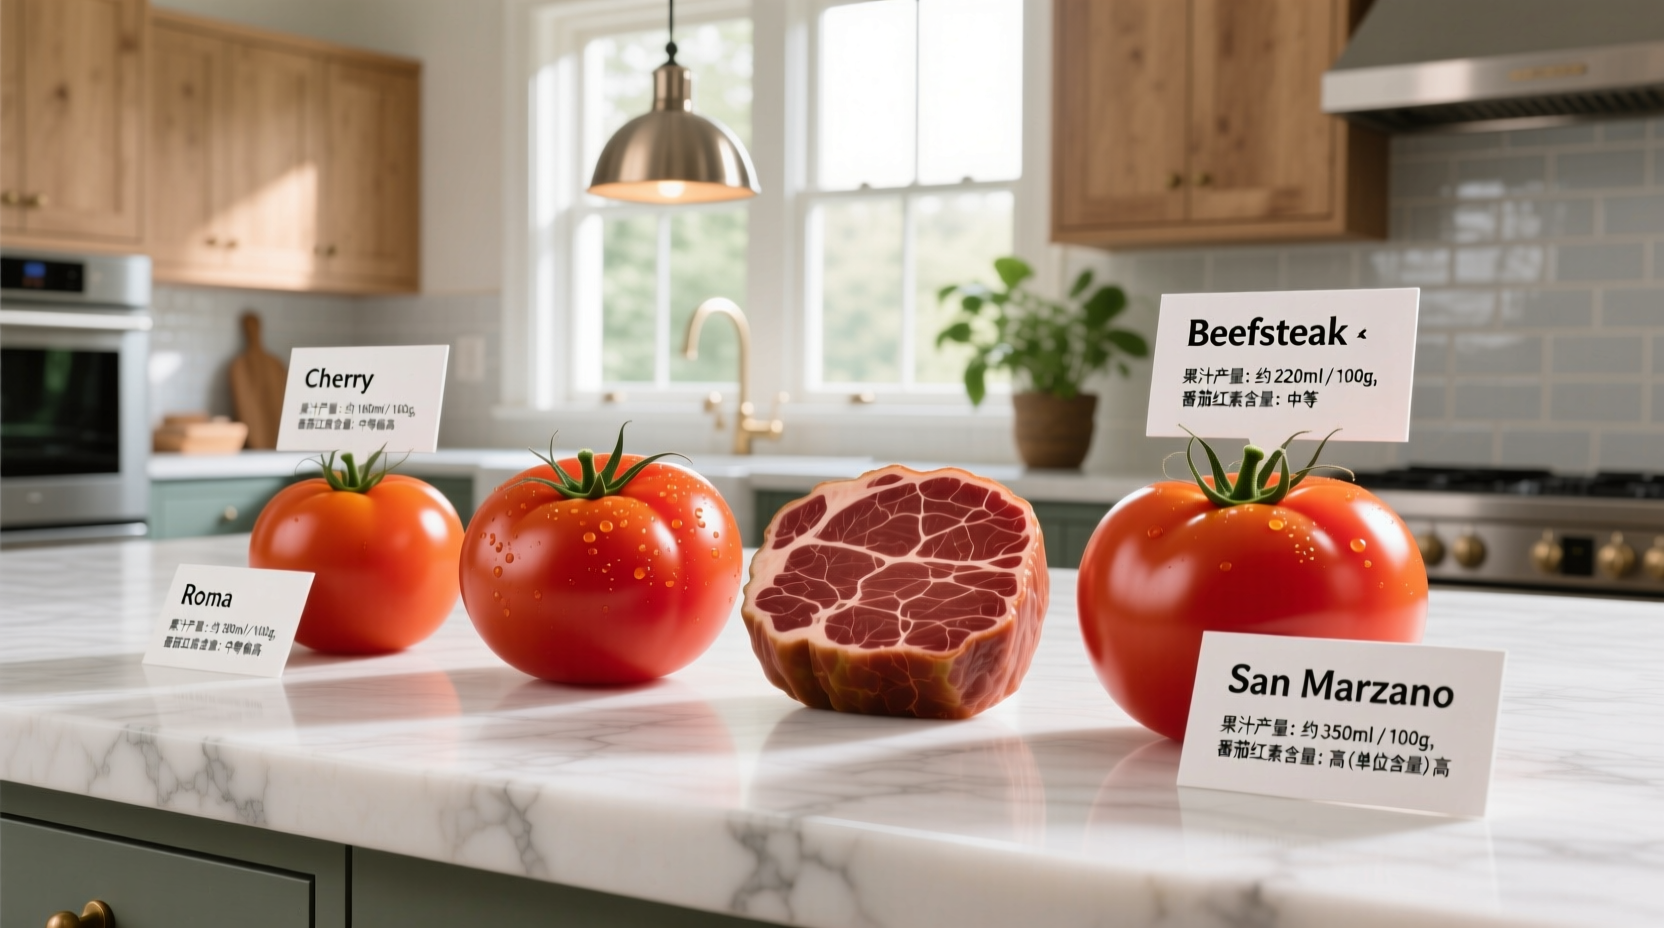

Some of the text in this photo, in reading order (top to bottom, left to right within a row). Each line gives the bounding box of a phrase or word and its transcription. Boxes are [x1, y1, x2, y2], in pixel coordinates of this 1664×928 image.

[1188, 316, 1349, 346] Beefsteak
[304, 367, 375, 395] Cherry
[181, 583, 233, 608] Roma
[1228, 663, 1455, 708] San Marzano
